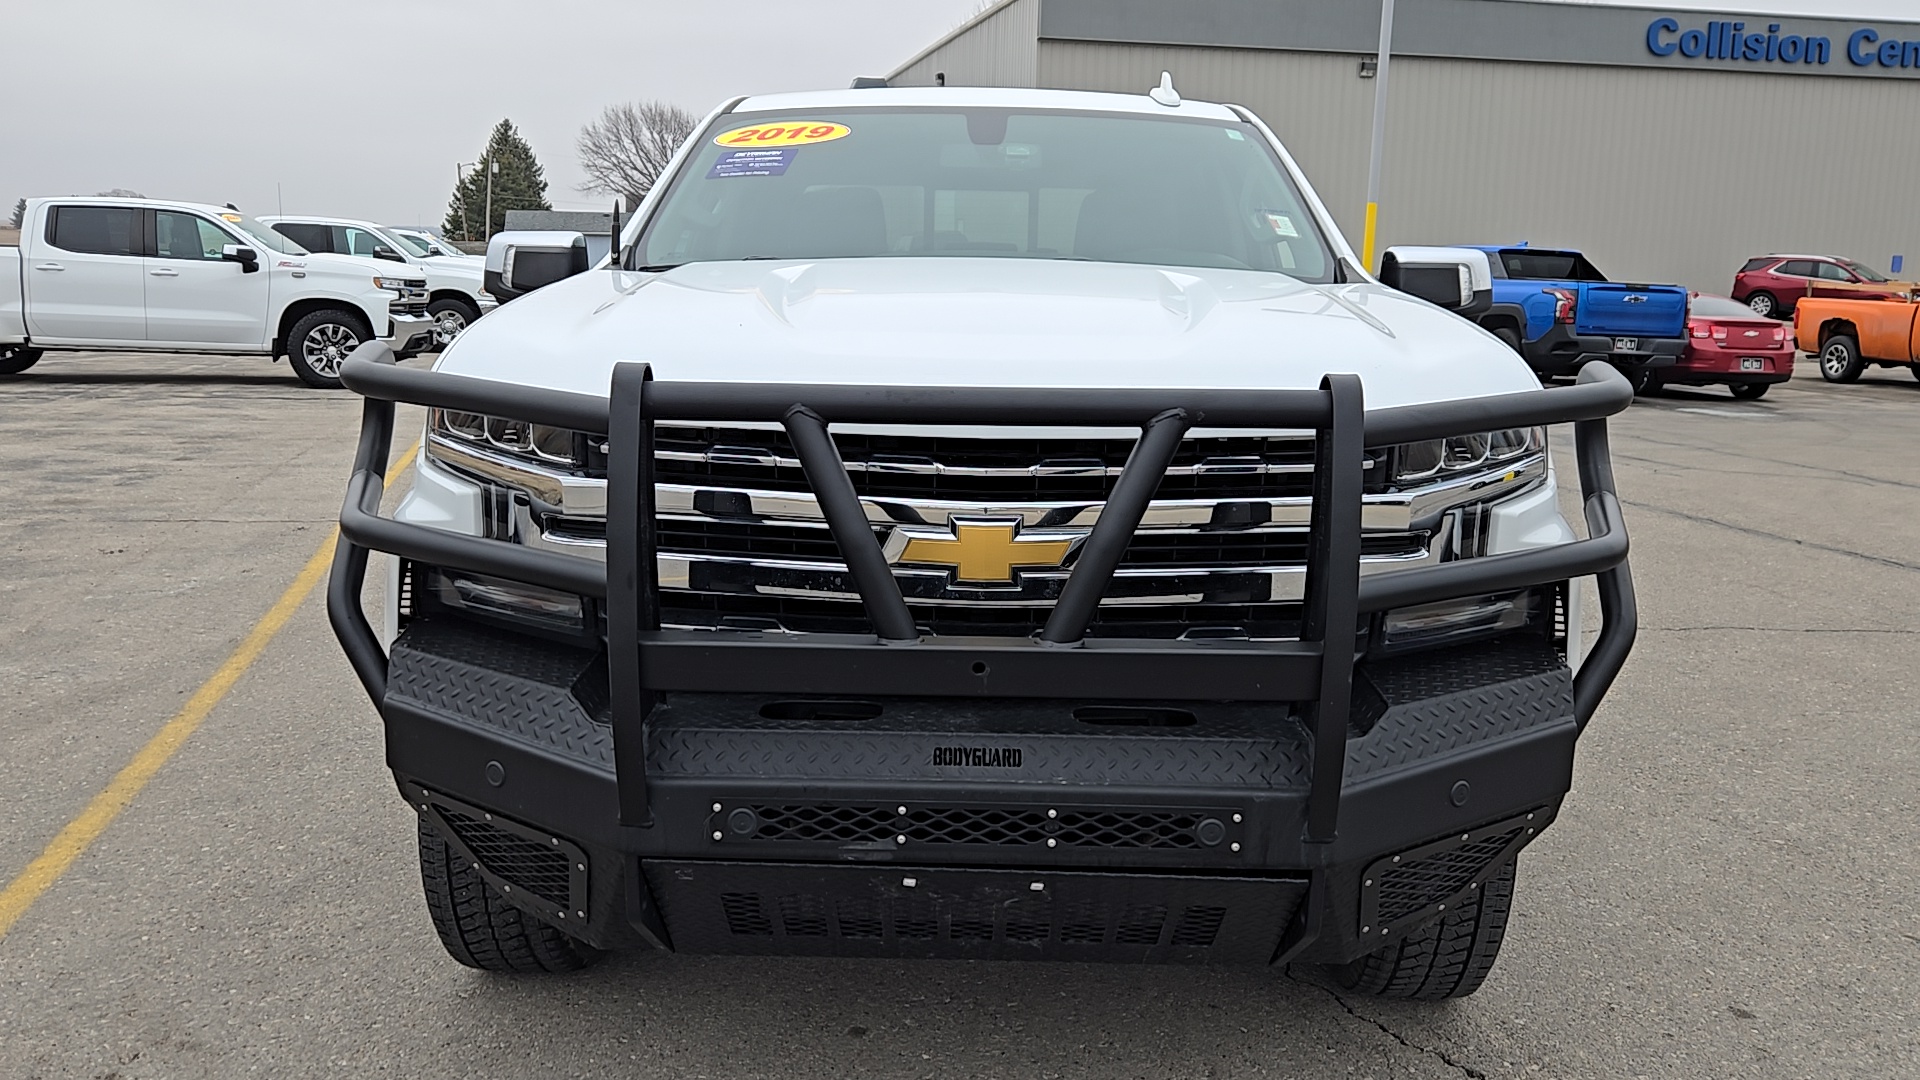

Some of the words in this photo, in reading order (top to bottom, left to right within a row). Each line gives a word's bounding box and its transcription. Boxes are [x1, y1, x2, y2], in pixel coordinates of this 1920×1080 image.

[1646, 17, 1831, 65] Collision
[728, 126, 835, 143] 2019
[933, 747, 1022, 767] BODYGUARD
